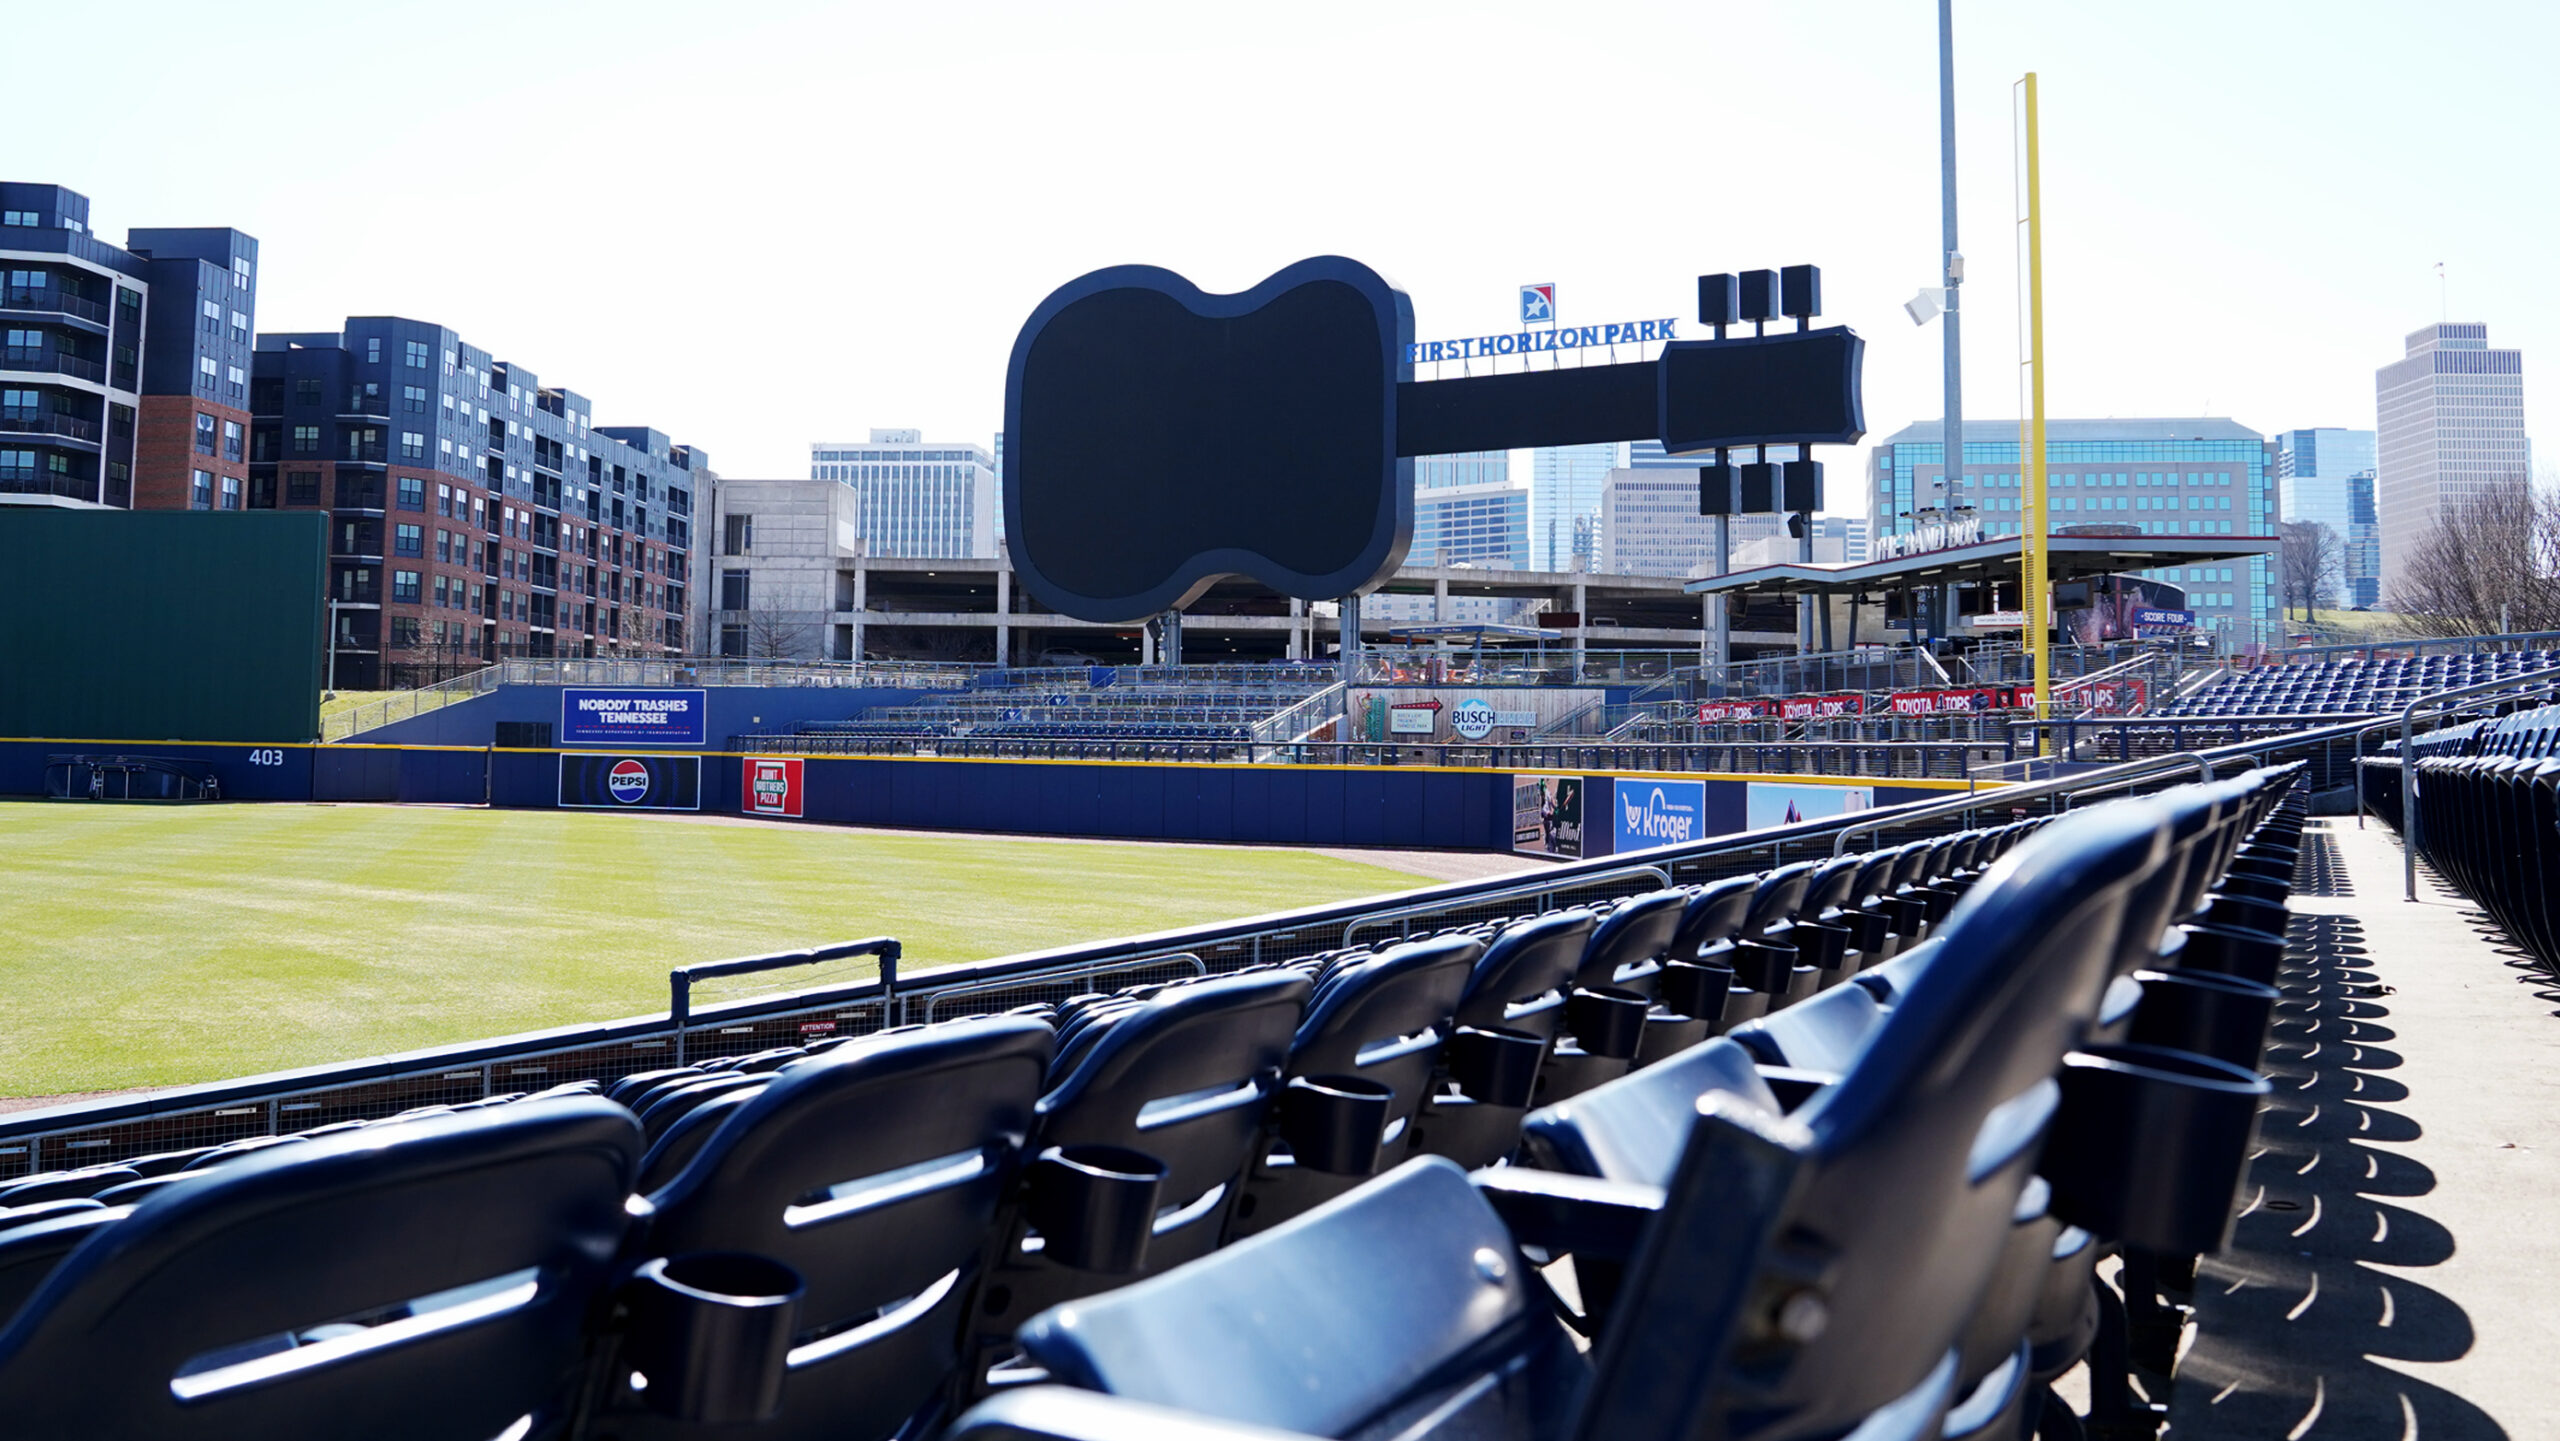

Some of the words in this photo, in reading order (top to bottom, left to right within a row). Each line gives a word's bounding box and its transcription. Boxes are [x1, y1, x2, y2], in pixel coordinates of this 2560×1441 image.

[1406, 338, 1474, 364] FIRST
[1479, 327, 1598, 356] HORIZON
[1605, 319, 1676, 344] PARK
[1904, 525, 1945, 556] BAND
[1947, 518, 1980, 548] BOX
[579, 699, 631, 711] NOBODY
[633, 699, 688, 712] TRASHES
[1784, 703, 1812, 718] TOYOTA
[1815, 699, 1822, 715] 4
[1822, 701, 1843, 716] TOPS
[1895, 697, 1932, 713] TOYOTA
[1935, 693, 1945, 711] 4
[1945, 694, 1970, 711] TOPS
[599, 712, 668, 724] TENNESSEE
[1453, 711, 1496, 725] BUSCH
[1702, 707, 1725, 720] TOYOTA
[1461, 724, 1487, 732] LIGHT
[249, 749, 283, 766] 403
[611, 776, 646, 787] PEPSI
[801, 1023, 835, 1031] ATTENTION
